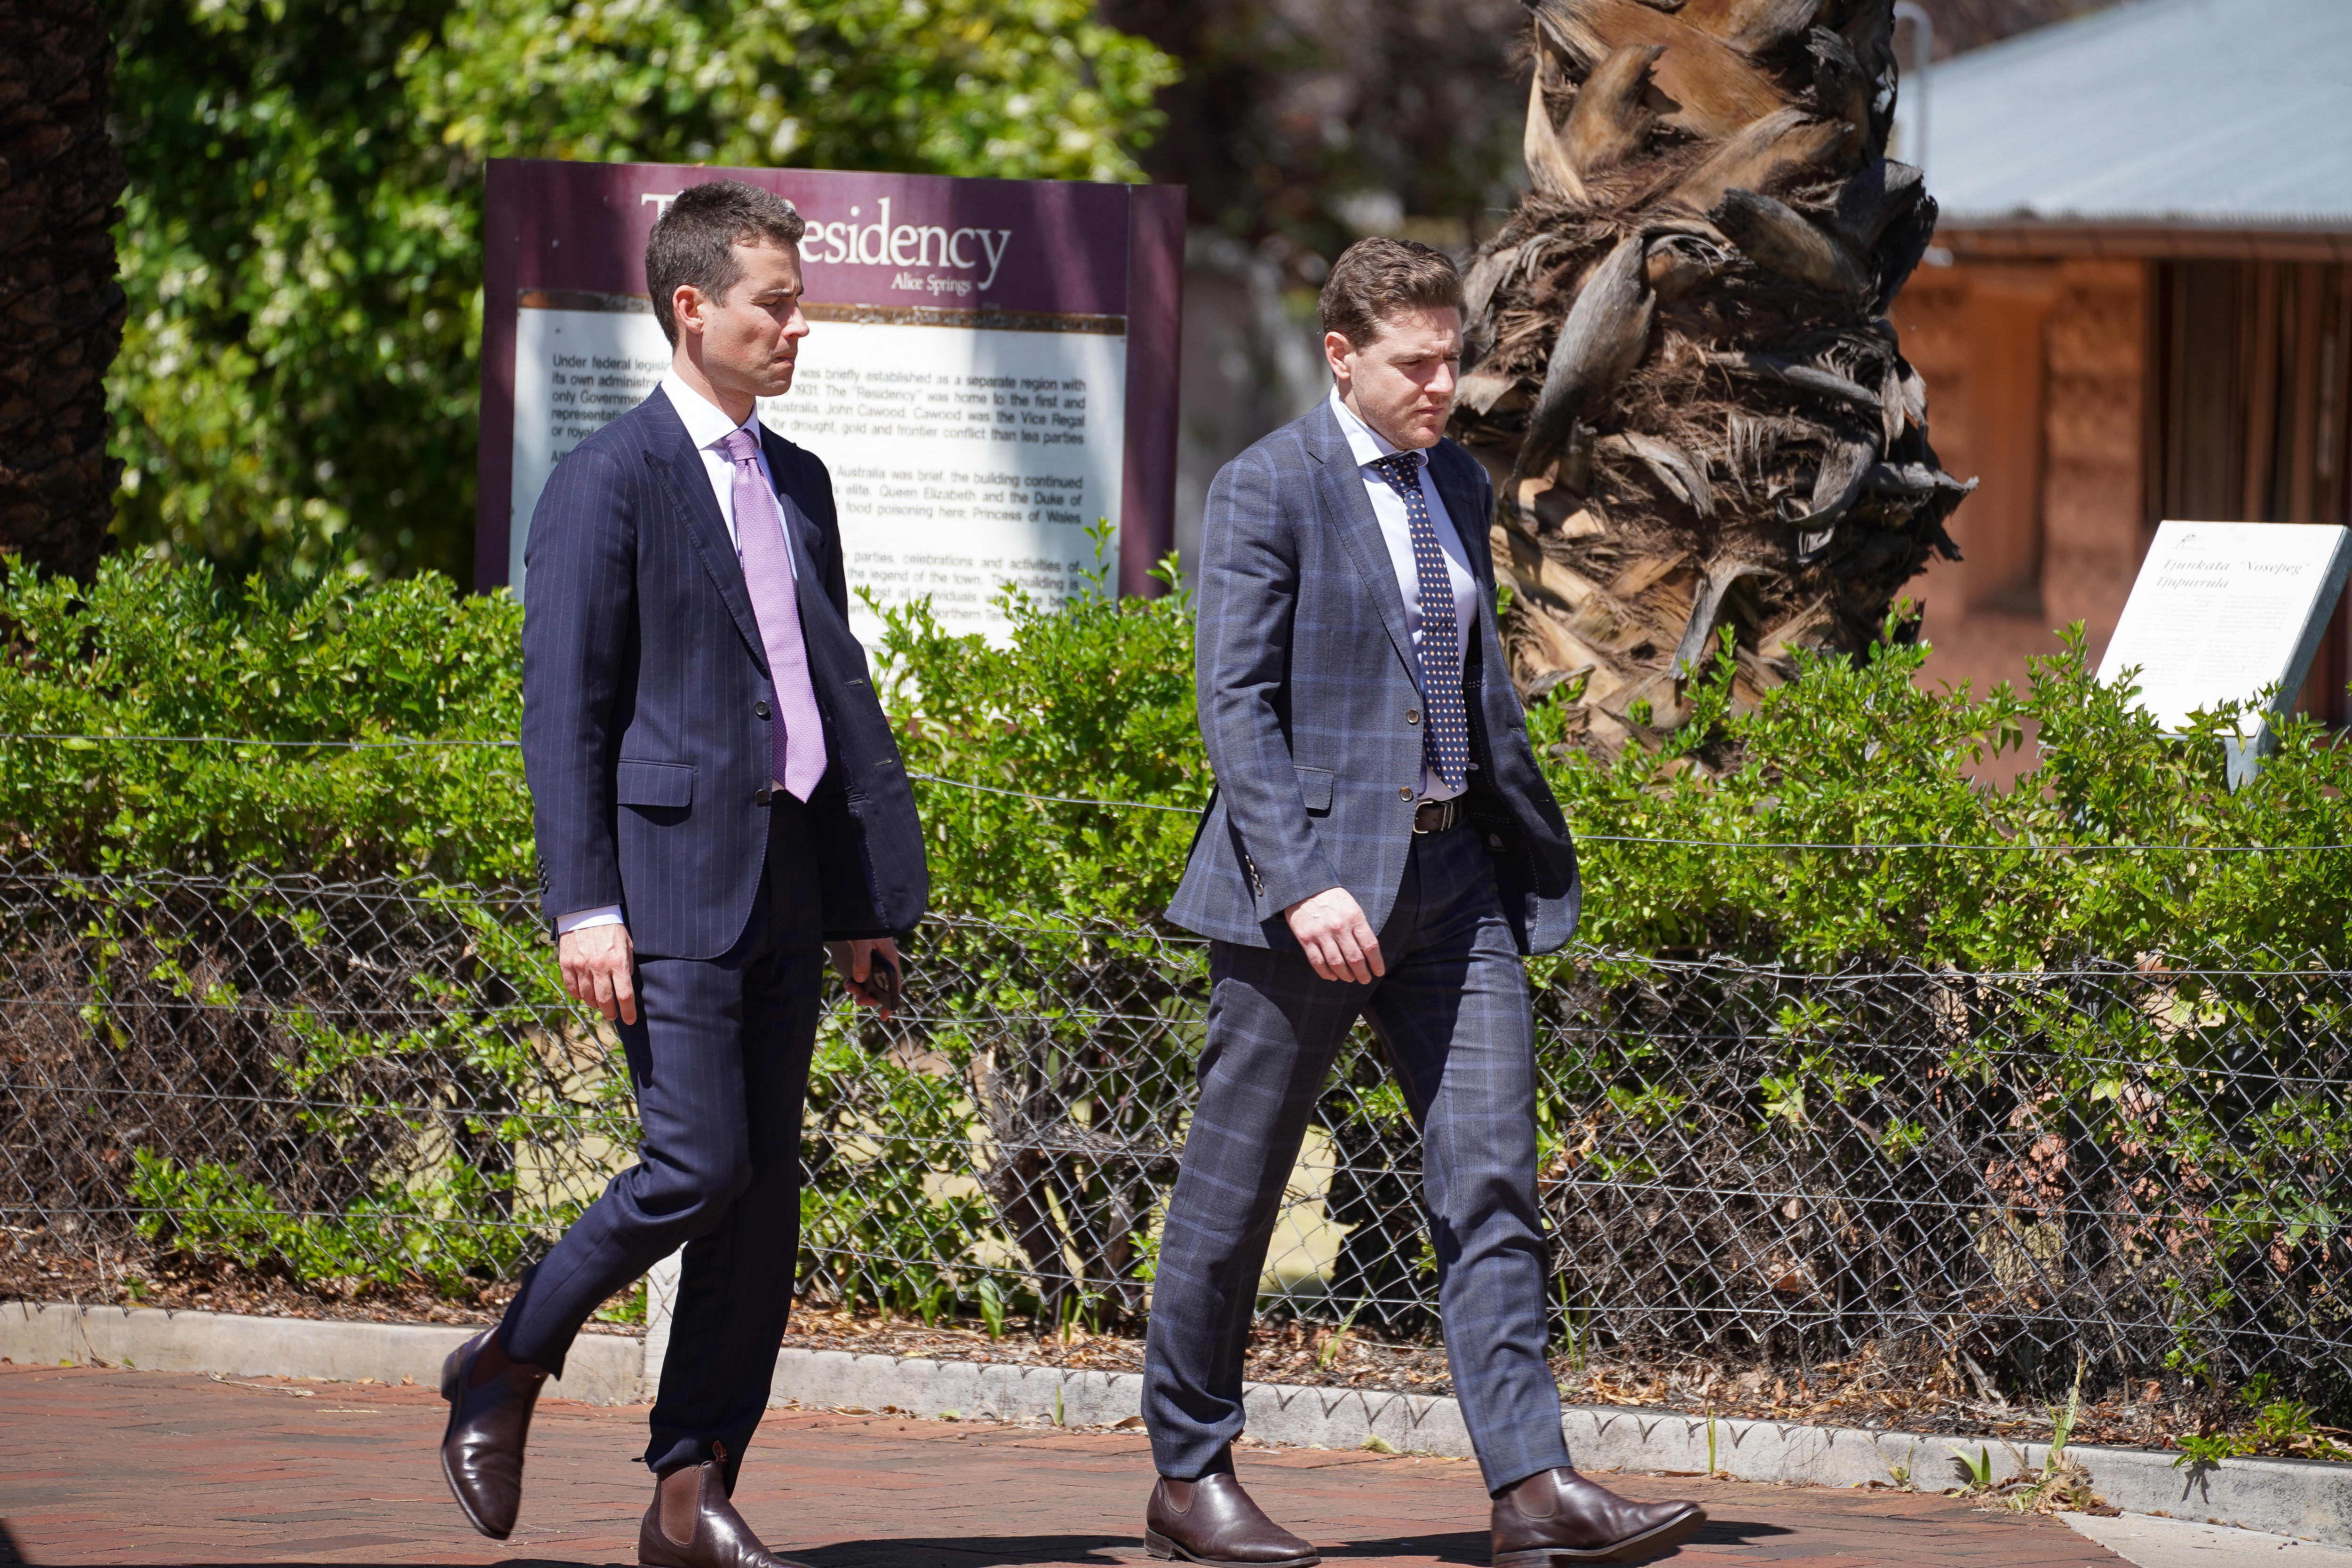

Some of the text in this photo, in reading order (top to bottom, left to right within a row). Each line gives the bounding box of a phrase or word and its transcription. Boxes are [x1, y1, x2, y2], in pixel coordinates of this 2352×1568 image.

[783, 197, 1013, 290] esidency
[891, 271, 972, 297] Alice Springs
[553, 354, 670, 372] Under federal legisla
[552, 372, 658, 389] its own administra
[800, 368, 1087, 392] was briefly established as a separate region with
[552, 390, 576, 405] only
[825, 384, 847, 398] The
[852, 386, 922, 403] "Residency"
[927, 392, 948, 402] was
[954, 390, 987, 404] home
[993, 391, 1005, 406] to
[1010, 392, 1029, 406] the
[1035, 394, 1058, 408] first
[1064, 395, 1086, 410] and
[826, 403, 853, 416] John
[914, 406, 961, 421] Cawood
[968, 411, 990, 423] was
[996, 410, 1015, 423] the
[1021, 411, 1047, 424] Vice
[1052, 412, 1085, 429] Regal
[551, 426, 595, 440] or royal
[771, 417, 785, 429] for
[842, 421, 867, 435] gold
[871, 422, 892, 435] and
[897, 424, 938, 437] frontier
[944, 427, 986, 440] conflict
[991, 428, 1017, 441] than
[1021, 429, 1040, 443] tea
[1043, 431, 1084, 446] parties
[837, 466, 885, 479] Australia
[890, 470, 913, 480] was
[952, 471, 969, 482] the
[974, 472, 1020, 488] building
[1024, 474, 1084, 489] continued
[880, 485, 917, 498] Queen
[924, 487, 976, 501] Elizabeth
[983, 491, 1004, 502] and
[1010, 491, 1029, 504] the
[1035, 492, 1065, 505] Duke
[1070, 493, 1082, 506] of
[846, 501, 871, 514] food
[877, 505, 933, 518] poisoning
[973, 507, 1022, 521] Princess
[1029, 509, 1041, 522] of
[1047, 509, 1081, 524] Wales
[903, 553, 973, 567] celebrations
[982, 557, 1002, 568] and
[1010, 557, 1061, 572] activities
[1068, 560, 1080, 573] of
[848, 567, 865, 579] the
[870, 570, 908, 583] legend
[914, 571, 924, 581] of
[930, 571, 947, 582] the
[1018, 576, 1064, 592] building
[1070, 577, 1079, 590] is
[898, 588, 910, 598] all
[919, 590, 977, 603] inividuals
